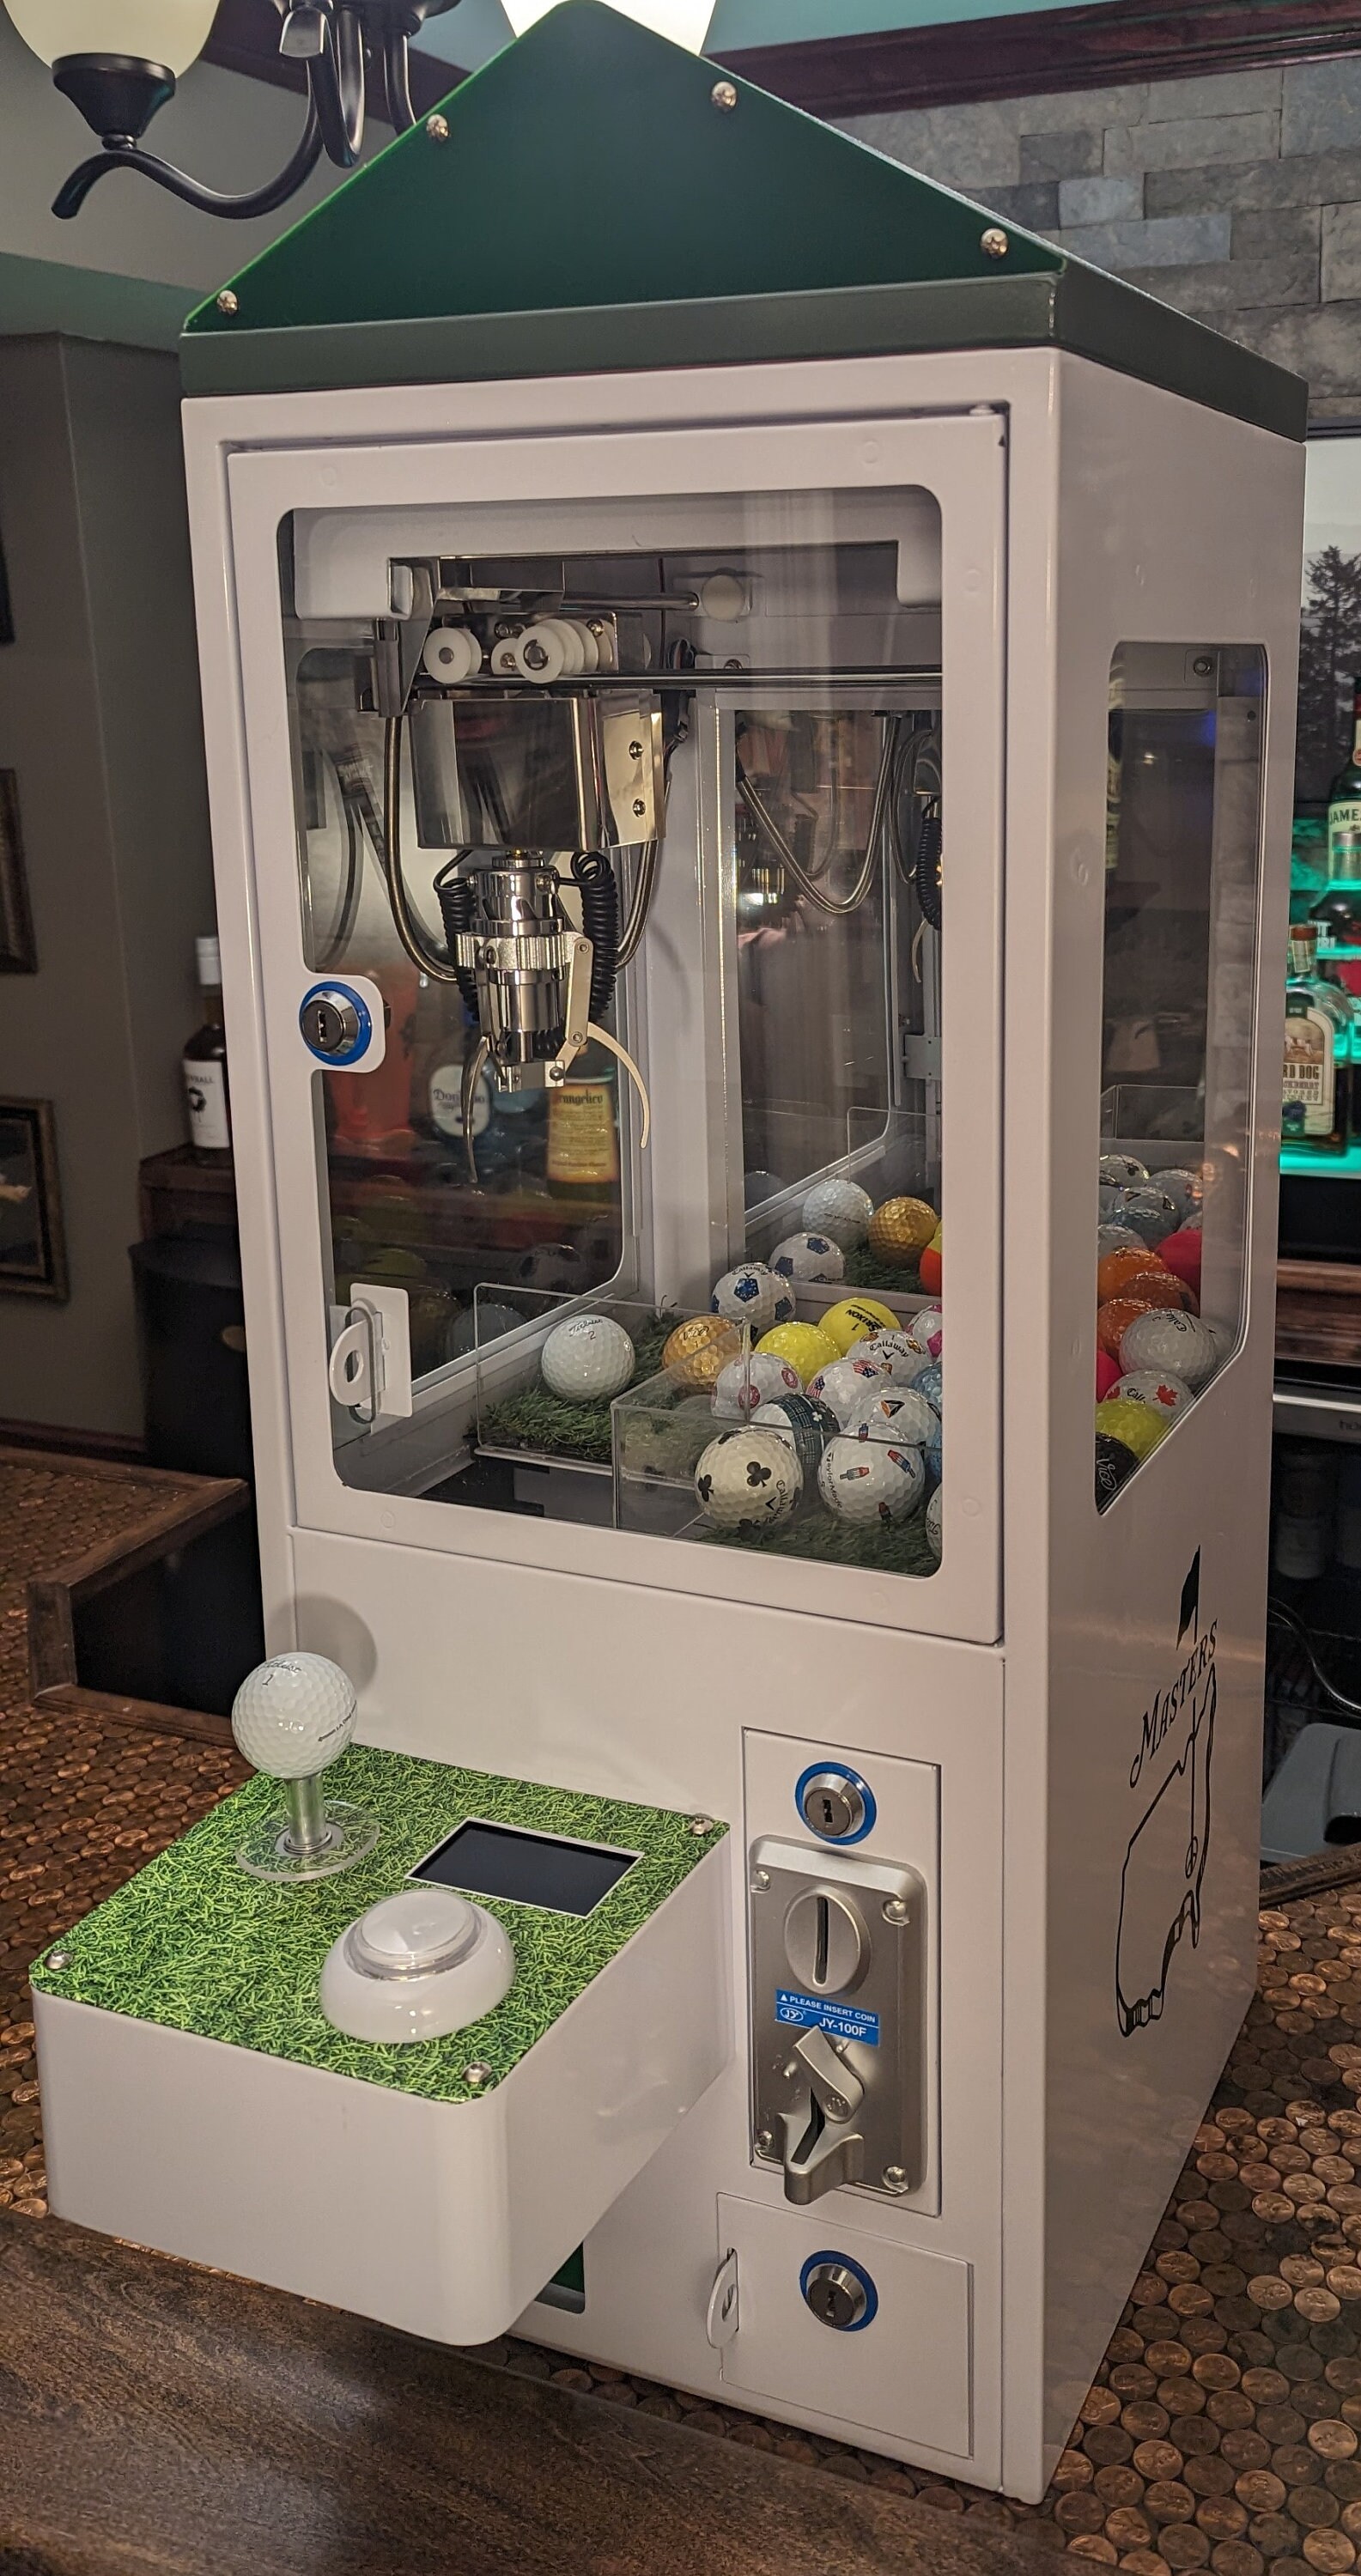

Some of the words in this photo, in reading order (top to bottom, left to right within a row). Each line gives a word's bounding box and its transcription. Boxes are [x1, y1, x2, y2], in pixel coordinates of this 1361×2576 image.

[1330, 809, 1361, 824] JAME
[1283, 1064, 1296, 1078] RD
[1298, 1065, 1320, 1080] DOG
[554, 1088, 604, 1106] rangelico
[845, 1309, 879, 1332] SRIXON
[588, 1330, 597, 1340] 2
[869, 1340, 908, 1358] Callaway
[1127, 1388, 1146, 1404] Call
[826, 1452, 842, 1509] TaylorMade
[766, 1479, 788, 1524] Callaway
[262, 1674, 274, 1686] 1
[1130, 1619, 1218, 1789] MASTERS
[789, 1996, 822, 2009] PLEASE
[823, 2004, 854, 2018] INSERT
[854, 2012, 876, 2023] COIN
[818, 2017, 867, 2037] JY-100F
